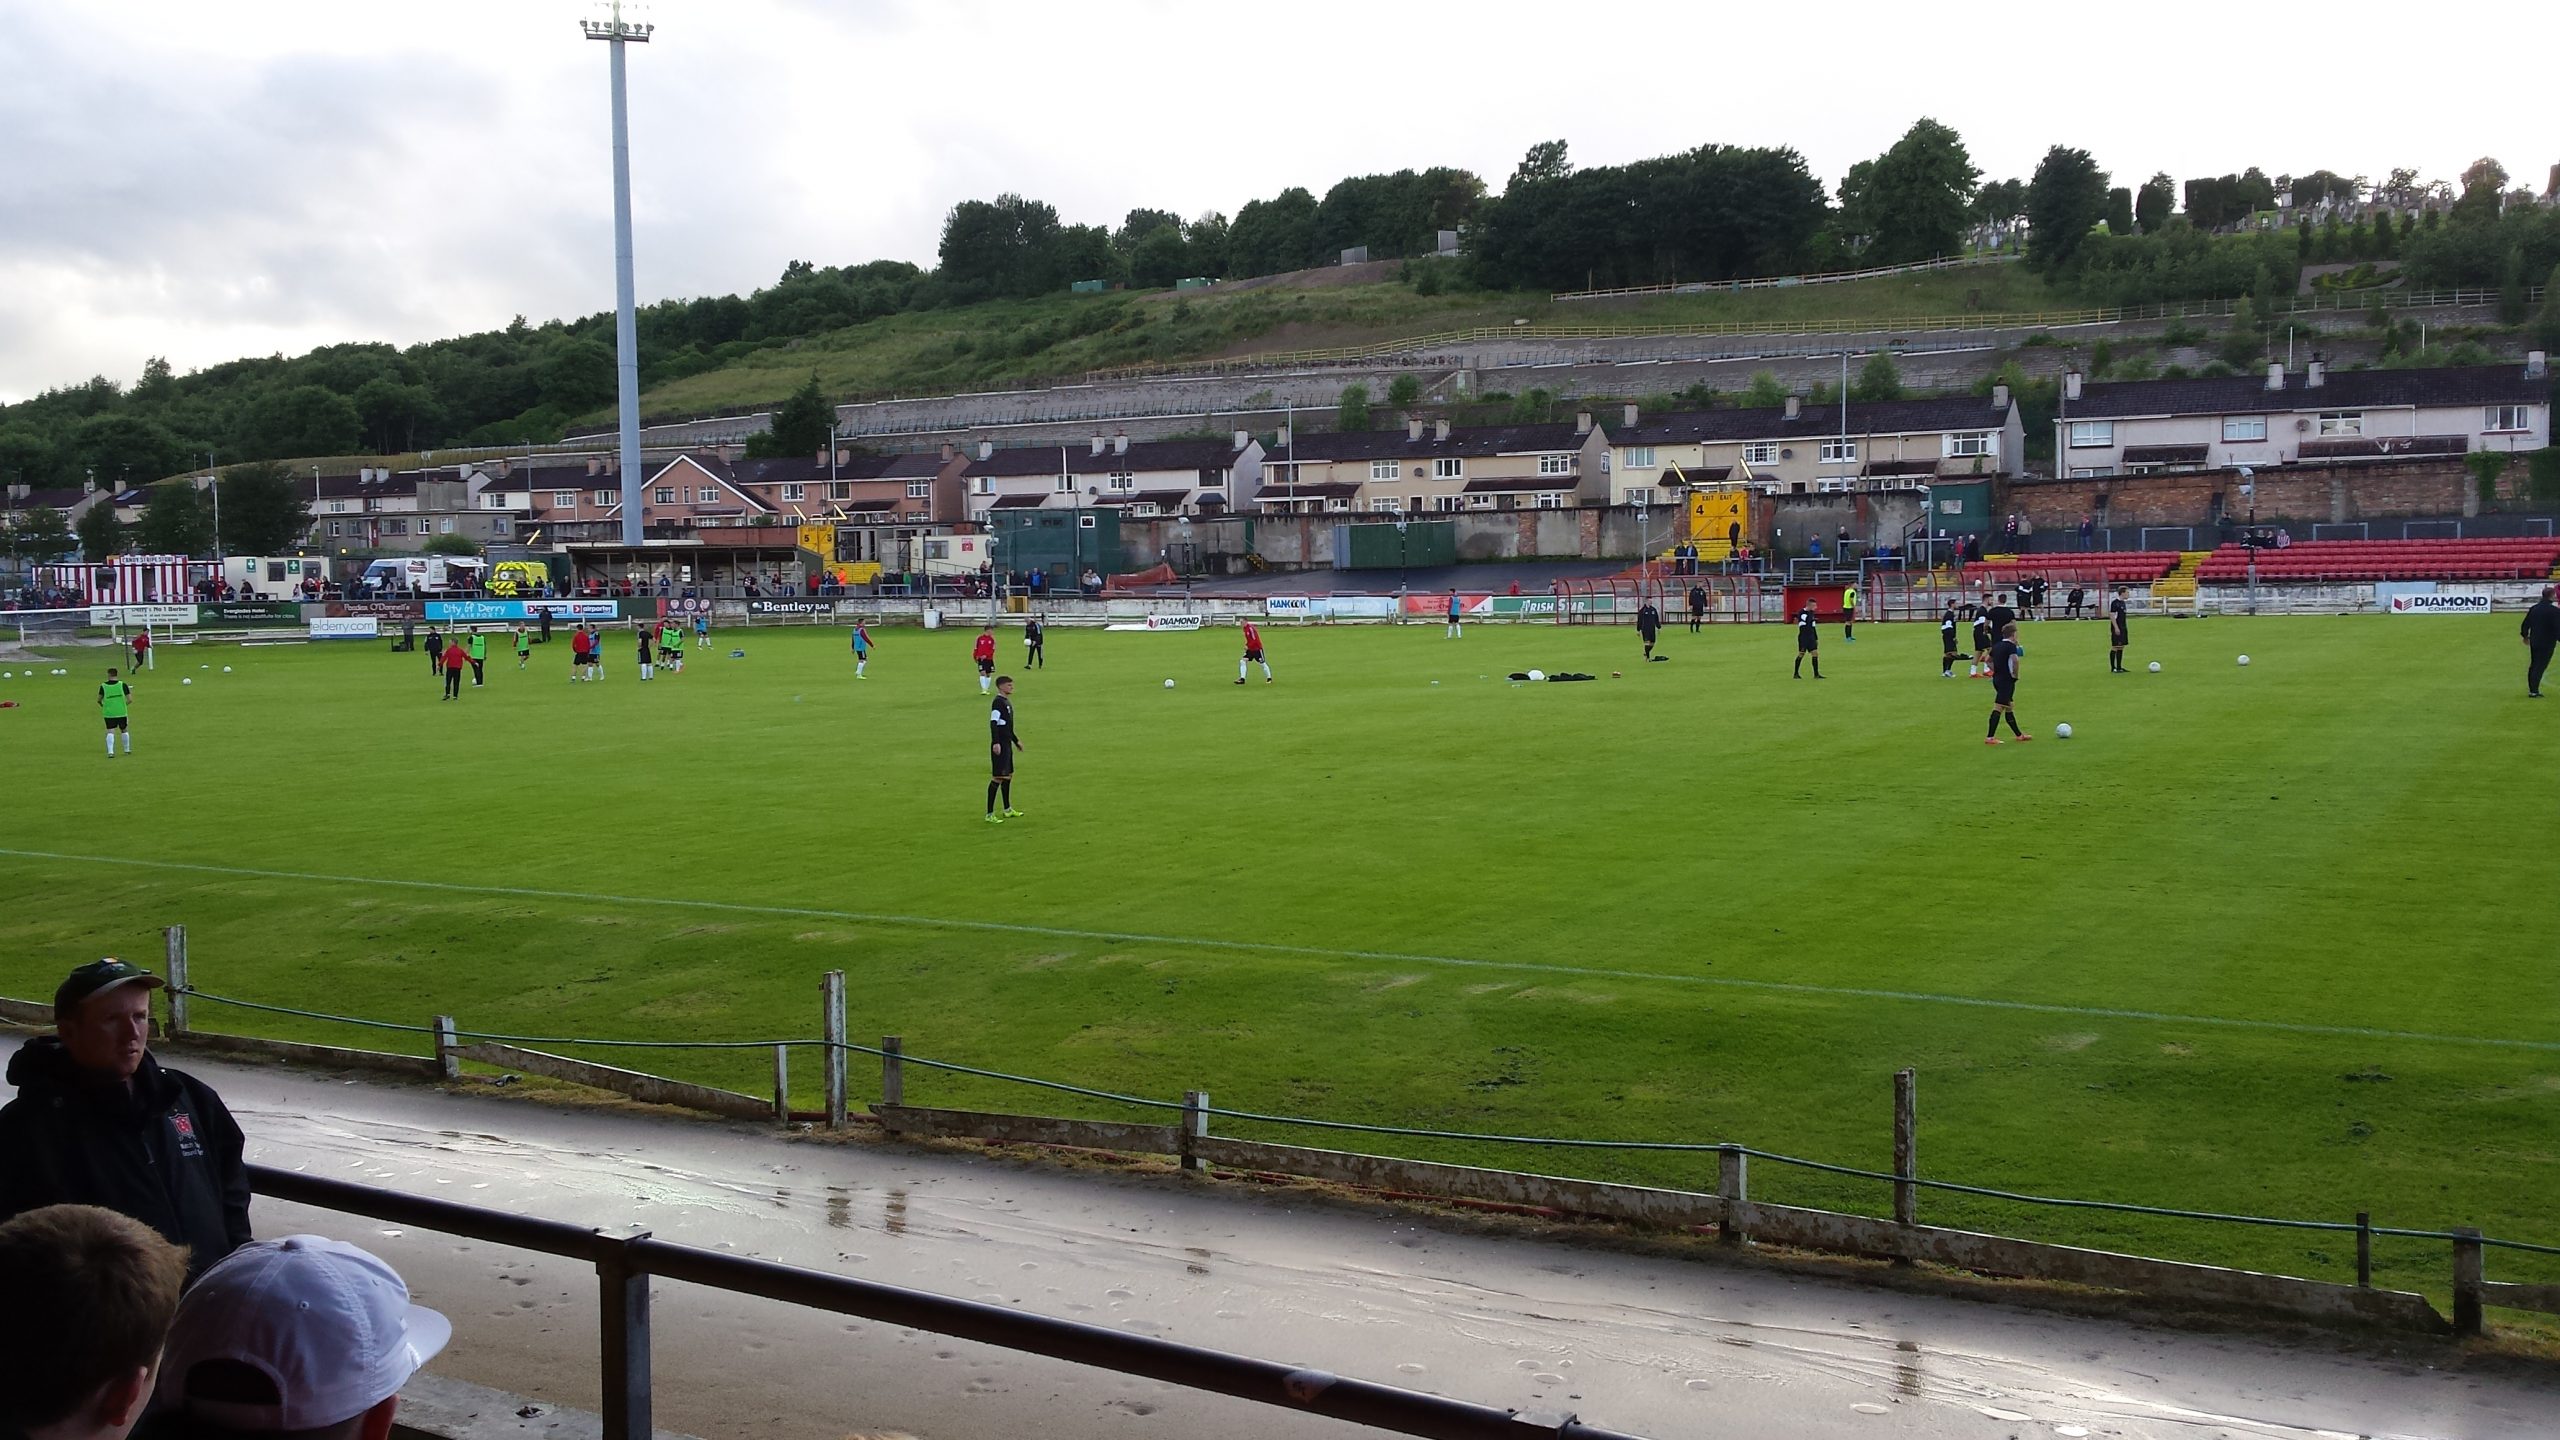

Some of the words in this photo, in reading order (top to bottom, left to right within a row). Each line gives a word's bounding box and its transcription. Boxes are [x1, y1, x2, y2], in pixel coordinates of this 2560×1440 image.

[1696, 504, 1704, 515] 4
[1730, 504, 1738, 515] 4
[804, 534, 810, 543] 5
[827, 533, 832, 542] 5
[762, 601, 814, 613] Bentley
[1558, 598, 1585, 611] SAR
[2414, 596, 2488, 607] DIAMOND
[443, 603, 461, 615] City
[478, 603, 506, 615] Derry
[582, 605, 612, 613] airporter
[1160, 617, 1200, 625] DIAMOND
